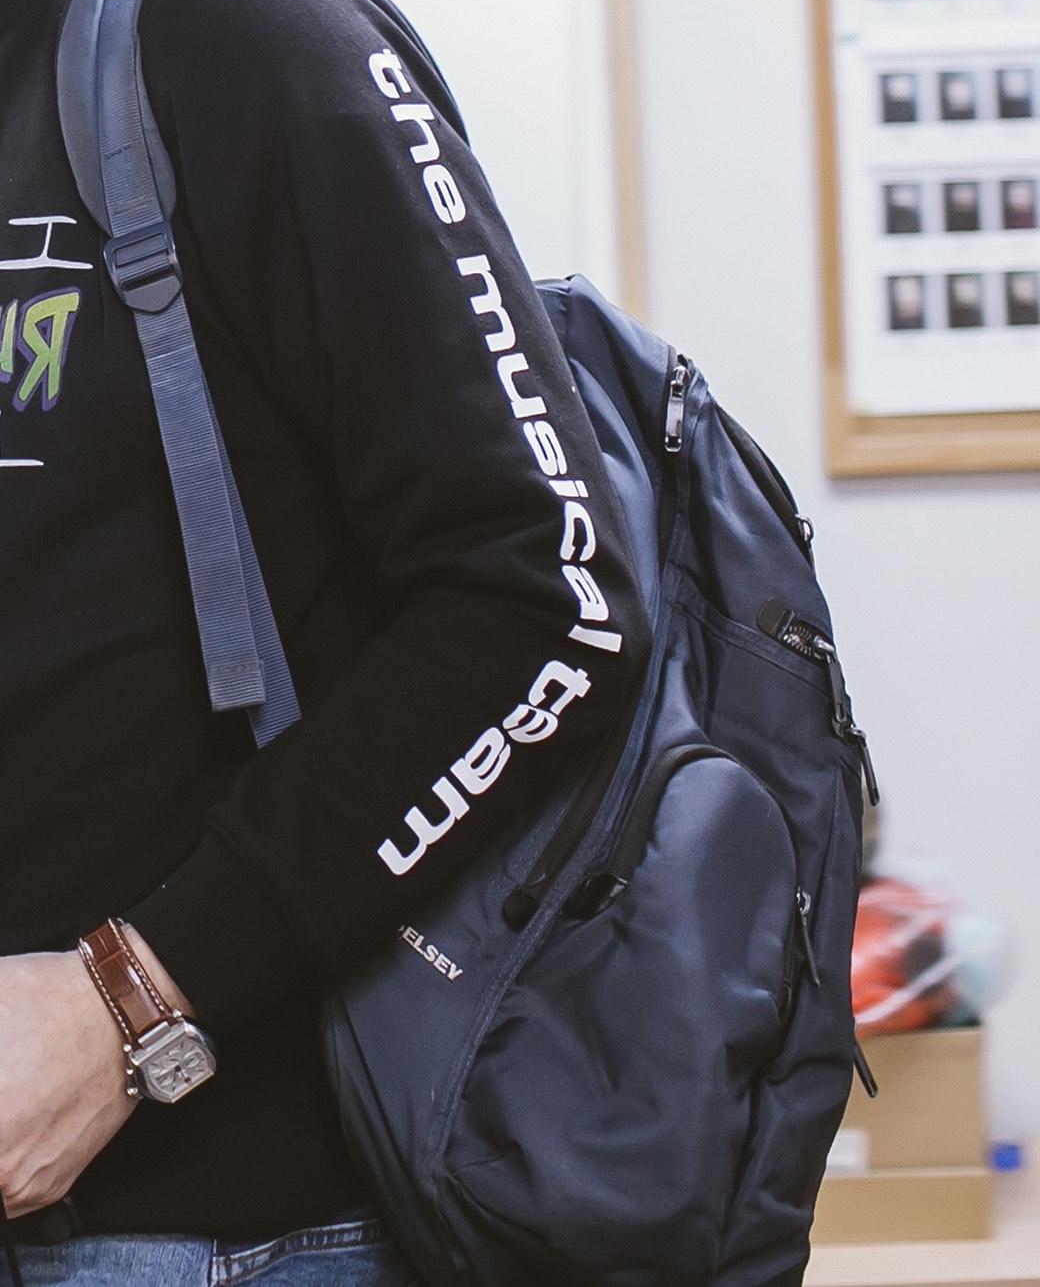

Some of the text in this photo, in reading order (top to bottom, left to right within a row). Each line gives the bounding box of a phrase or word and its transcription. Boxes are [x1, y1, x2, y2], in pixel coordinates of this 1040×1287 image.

[368, 48, 623, 876] the musical team
